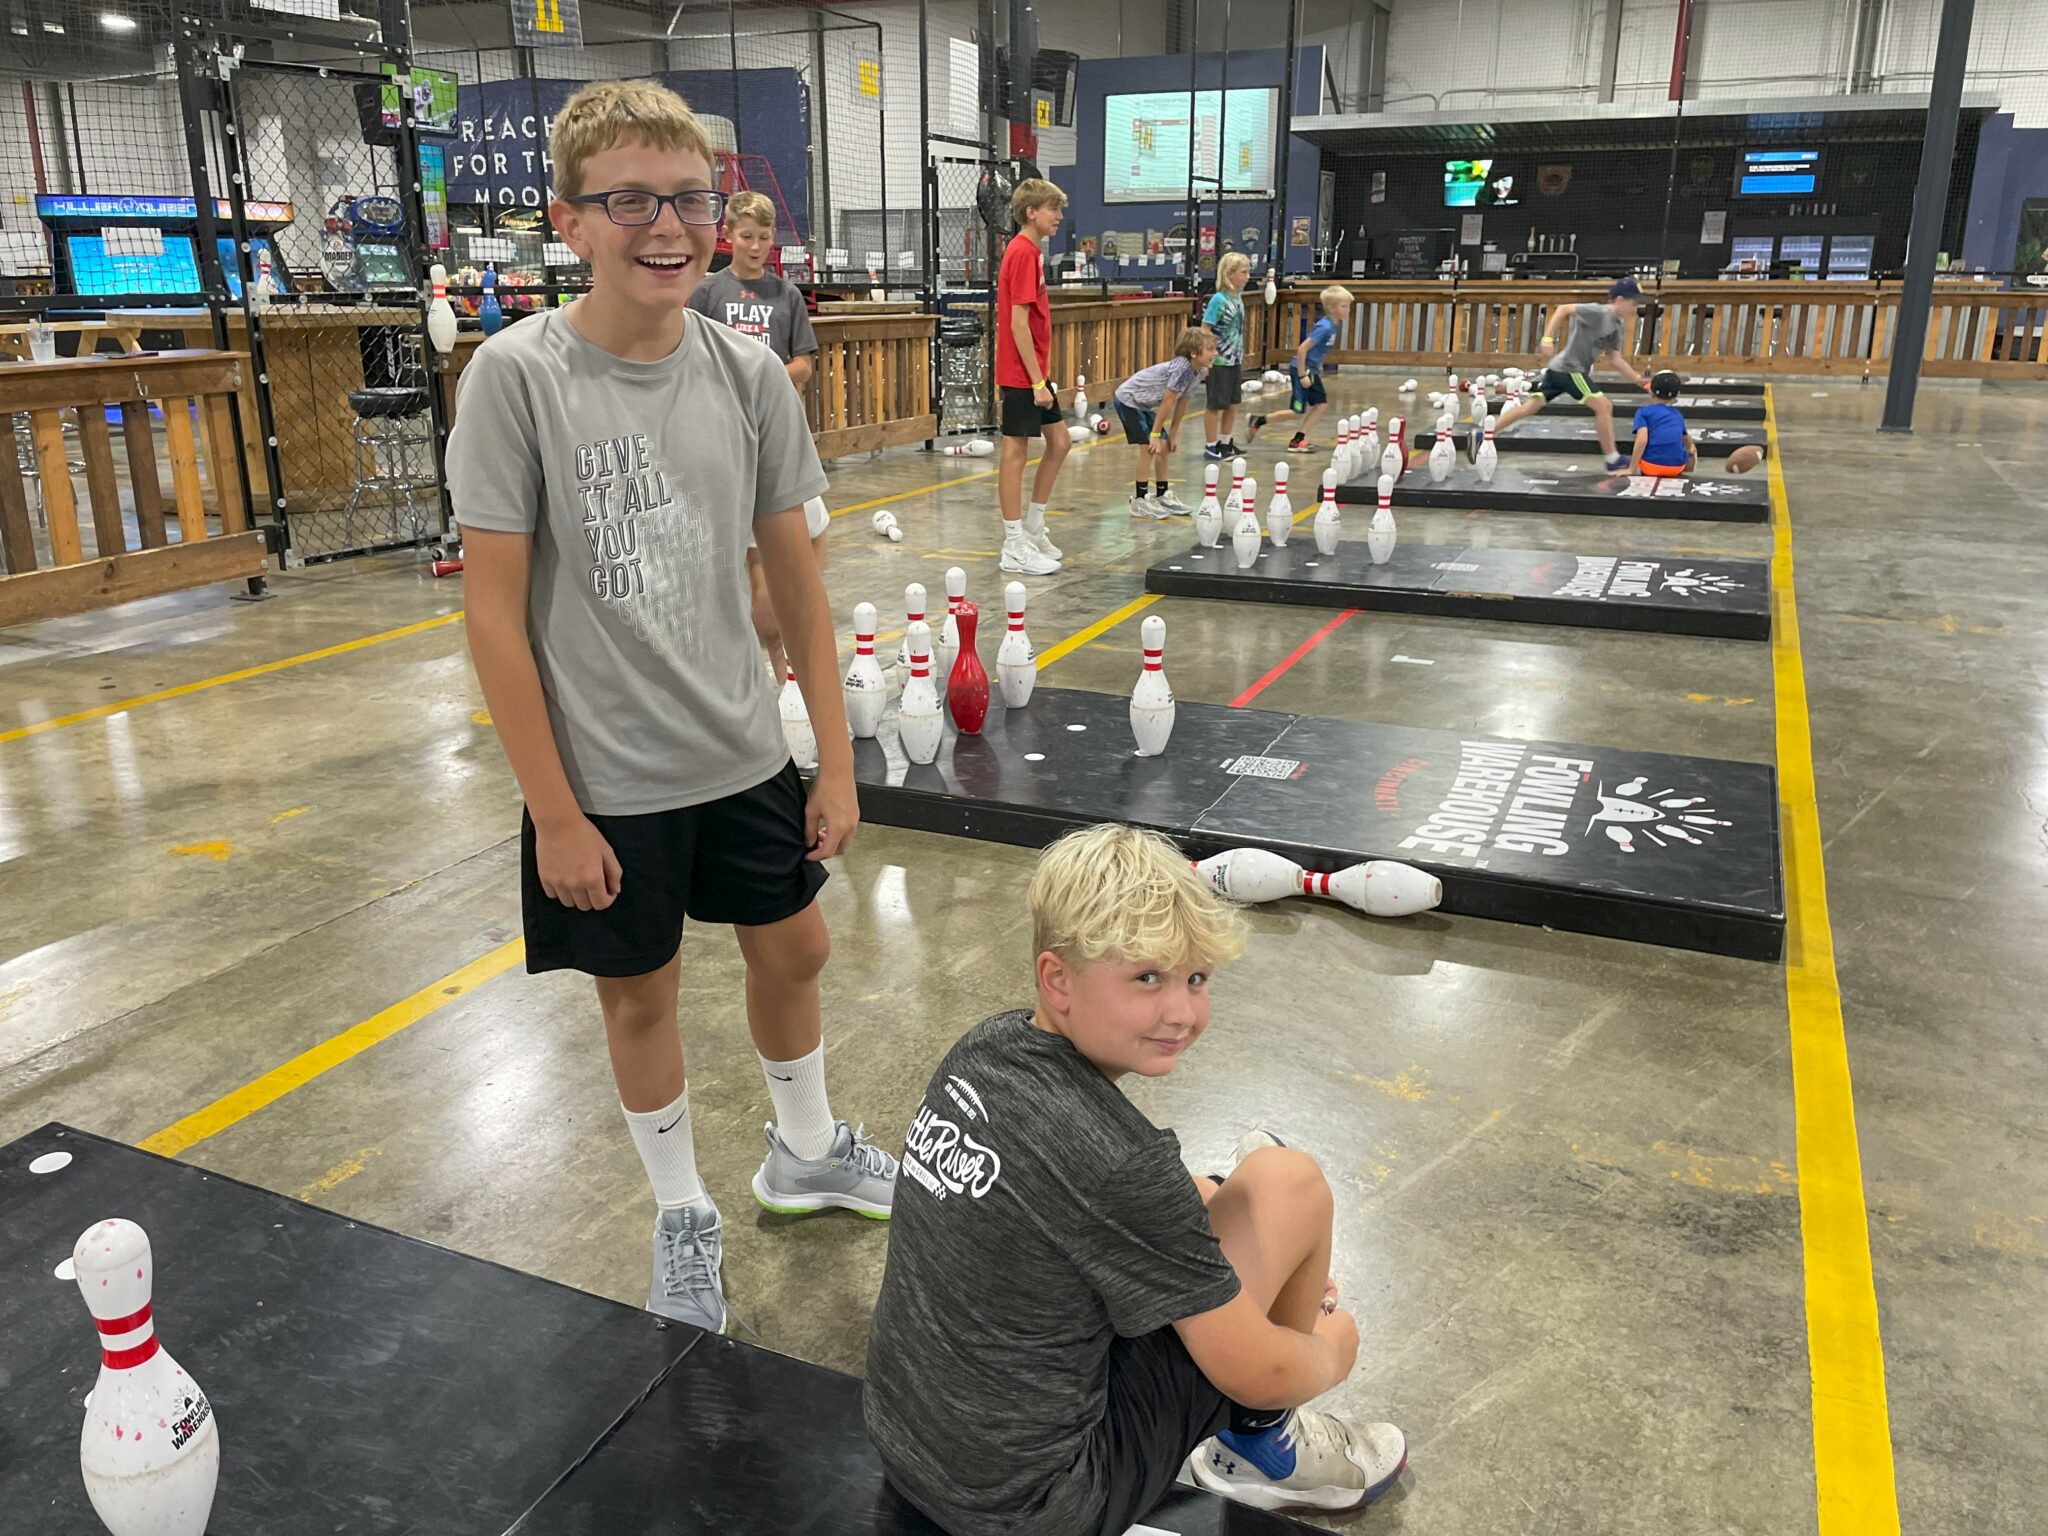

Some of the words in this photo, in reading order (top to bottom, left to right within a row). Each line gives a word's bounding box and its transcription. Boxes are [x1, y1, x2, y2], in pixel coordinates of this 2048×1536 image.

[461, 115, 555, 142] REACH
[453, 152, 508, 177] FOR
[521, 150, 554, 174] TH
[725, 303, 774, 328] PLAY
[753, 325, 760, 333] A
[575, 433, 652, 481] GIVE
[578, 483, 612, 524] IT
[623, 471, 673, 516] ALL
[584, 519, 638, 563] YOU
[589, 558, 646, 600] GOT
[1397, 740, 1528, 858] WAREHOUSE
[1493, 754, 1594, 856] FOWLING
[171, 1395, 206, 1436] FOWLING
